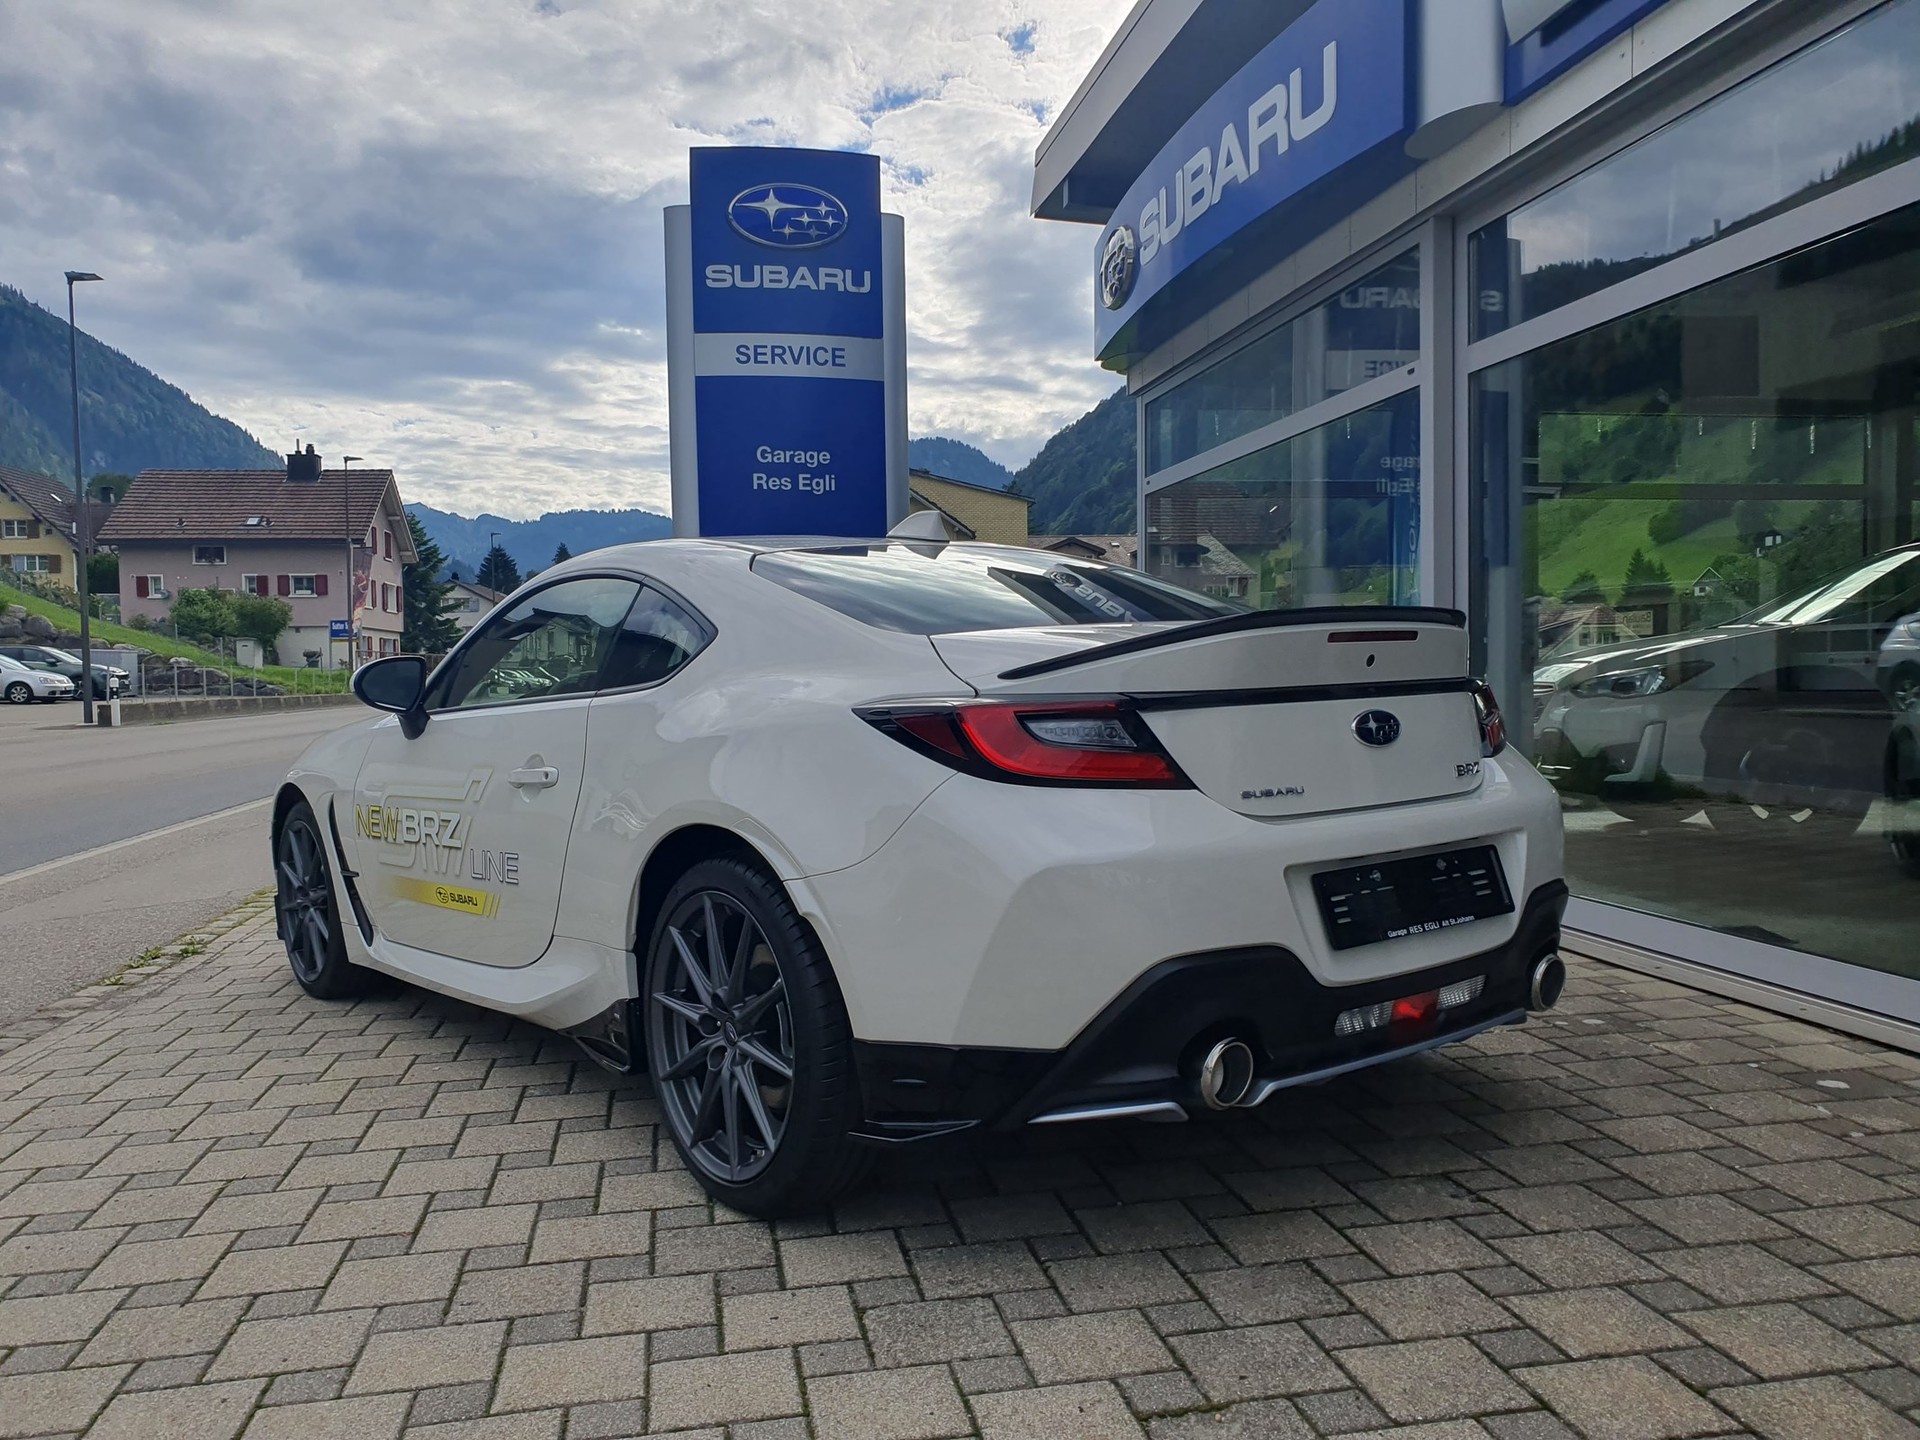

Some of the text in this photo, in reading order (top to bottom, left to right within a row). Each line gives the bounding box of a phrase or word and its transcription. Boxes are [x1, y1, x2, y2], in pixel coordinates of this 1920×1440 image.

[1139, 40, 1337, 267] SUBARU
[705, 264, 870, 293] SUBARU
[735, 344, 846, 367] SERVICE
[756, 446, 831, 466] Garage
[752, 473, 836, 495] Res Egli
[1454, 761, 1481, 777] BRZ
[1241, 786, 1305, 799] SUBARU
[356, 804, 462, 849] NEW BRZ
[470, 848, 520, 885] LINE
[450, 892, 479, 907] SUBARU
[1387, 928, 1408, 938] Garage
[1409, 924, 1423, 935] RES
[1424, 920, 1440, 931] EGLI
